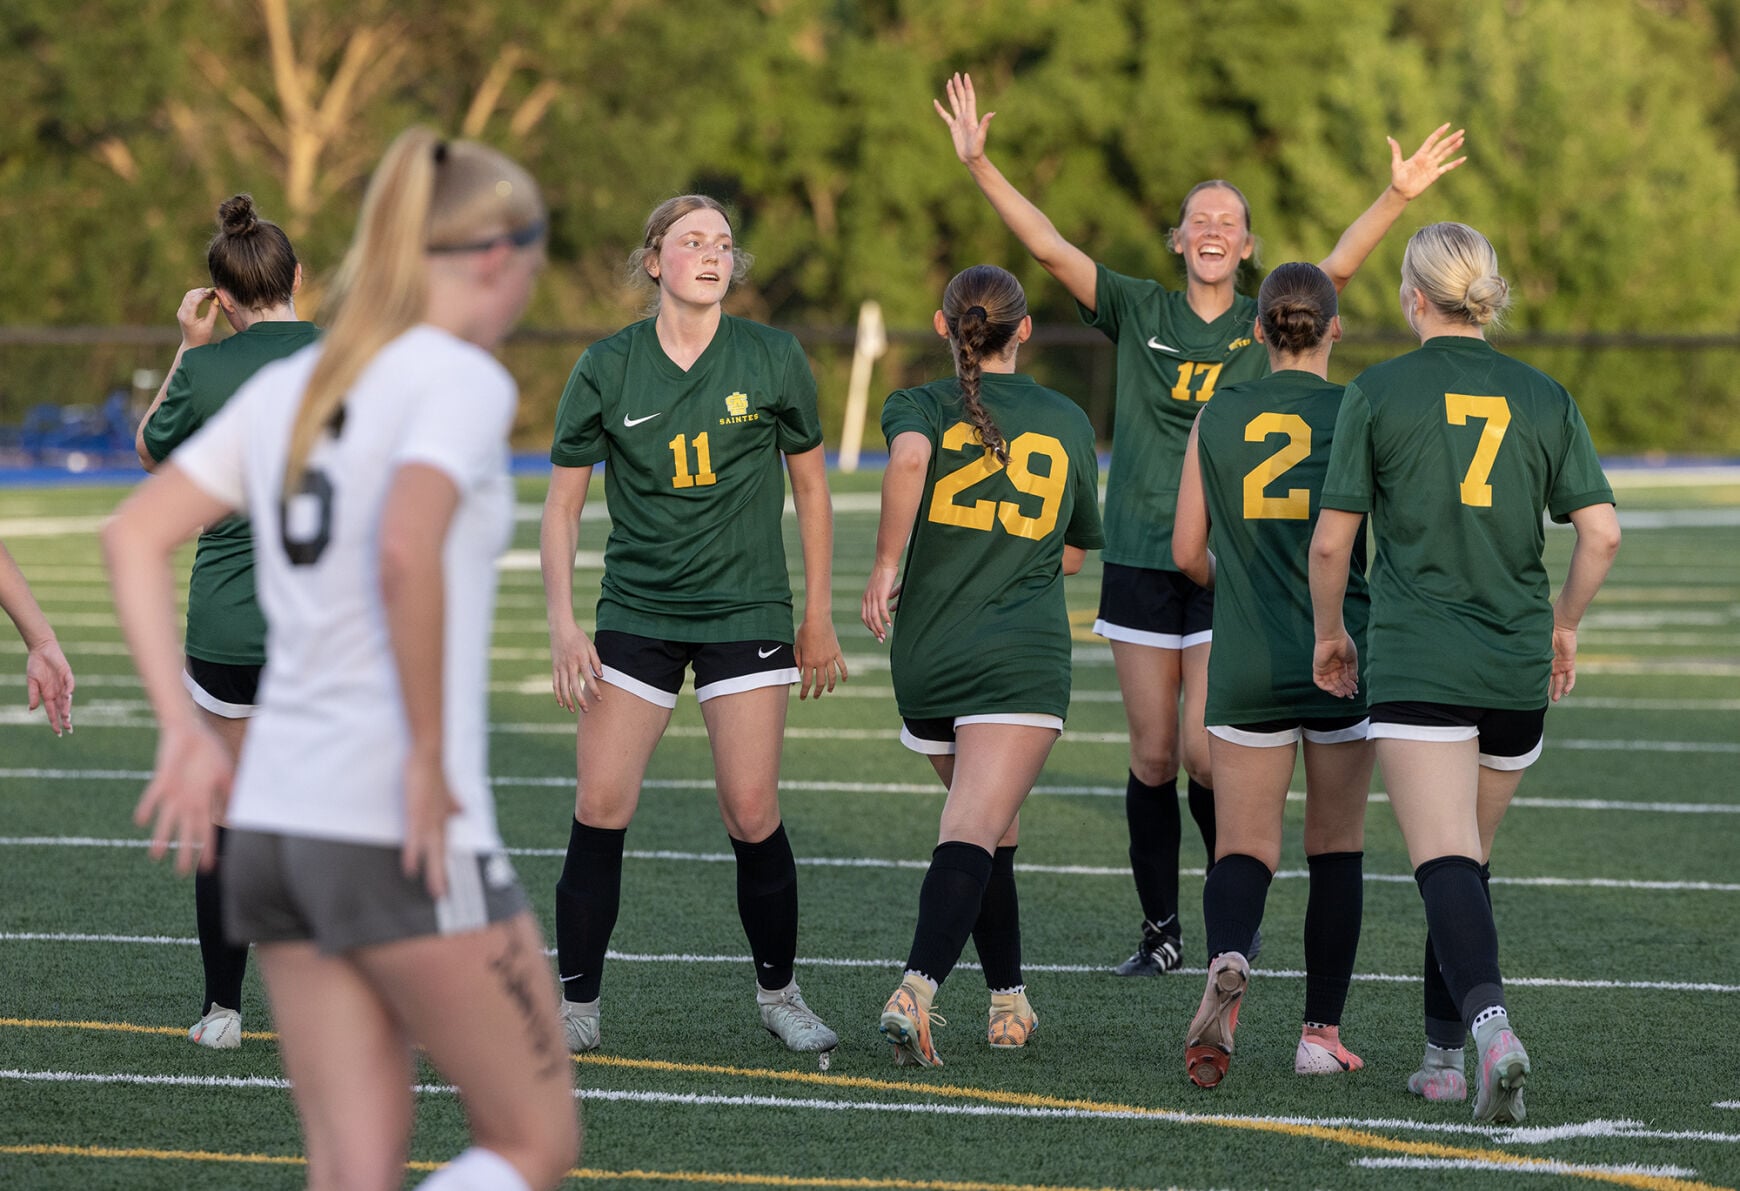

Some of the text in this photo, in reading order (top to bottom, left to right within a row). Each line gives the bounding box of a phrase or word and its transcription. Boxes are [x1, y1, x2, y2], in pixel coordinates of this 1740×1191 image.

[720, 413, 759, 425] SAINTES
[1171, 361, 1223, 402] 17
[669, 431, 717, 488] 11
[928, 421, 1069, 541] 29
[1243, 412, 1311, 519] 2
[1445, 393, 1511, 507] 7
